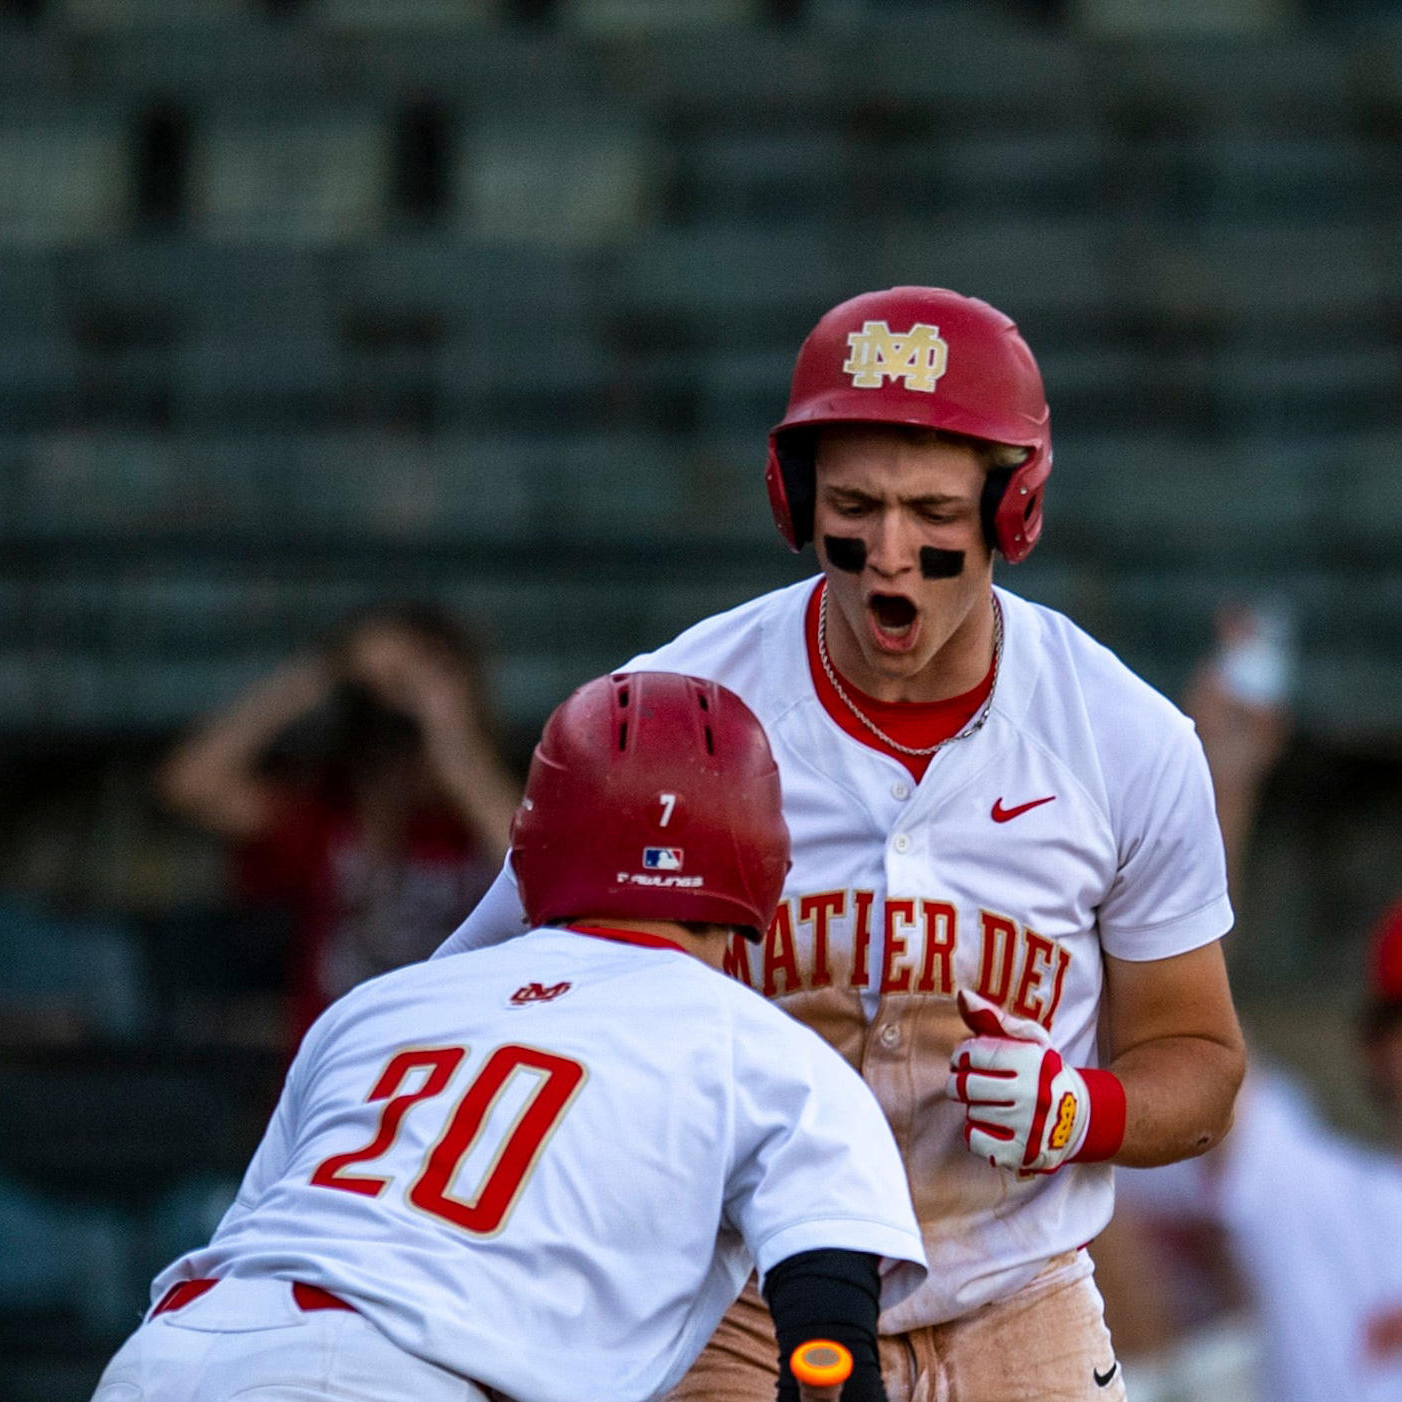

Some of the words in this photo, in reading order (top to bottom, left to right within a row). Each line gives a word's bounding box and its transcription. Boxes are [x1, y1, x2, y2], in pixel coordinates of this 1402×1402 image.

[659, 793, 676, 827] 7
[977, 908, 1073, 1034] DEI
[309, 1042, 590, 1241] 20
